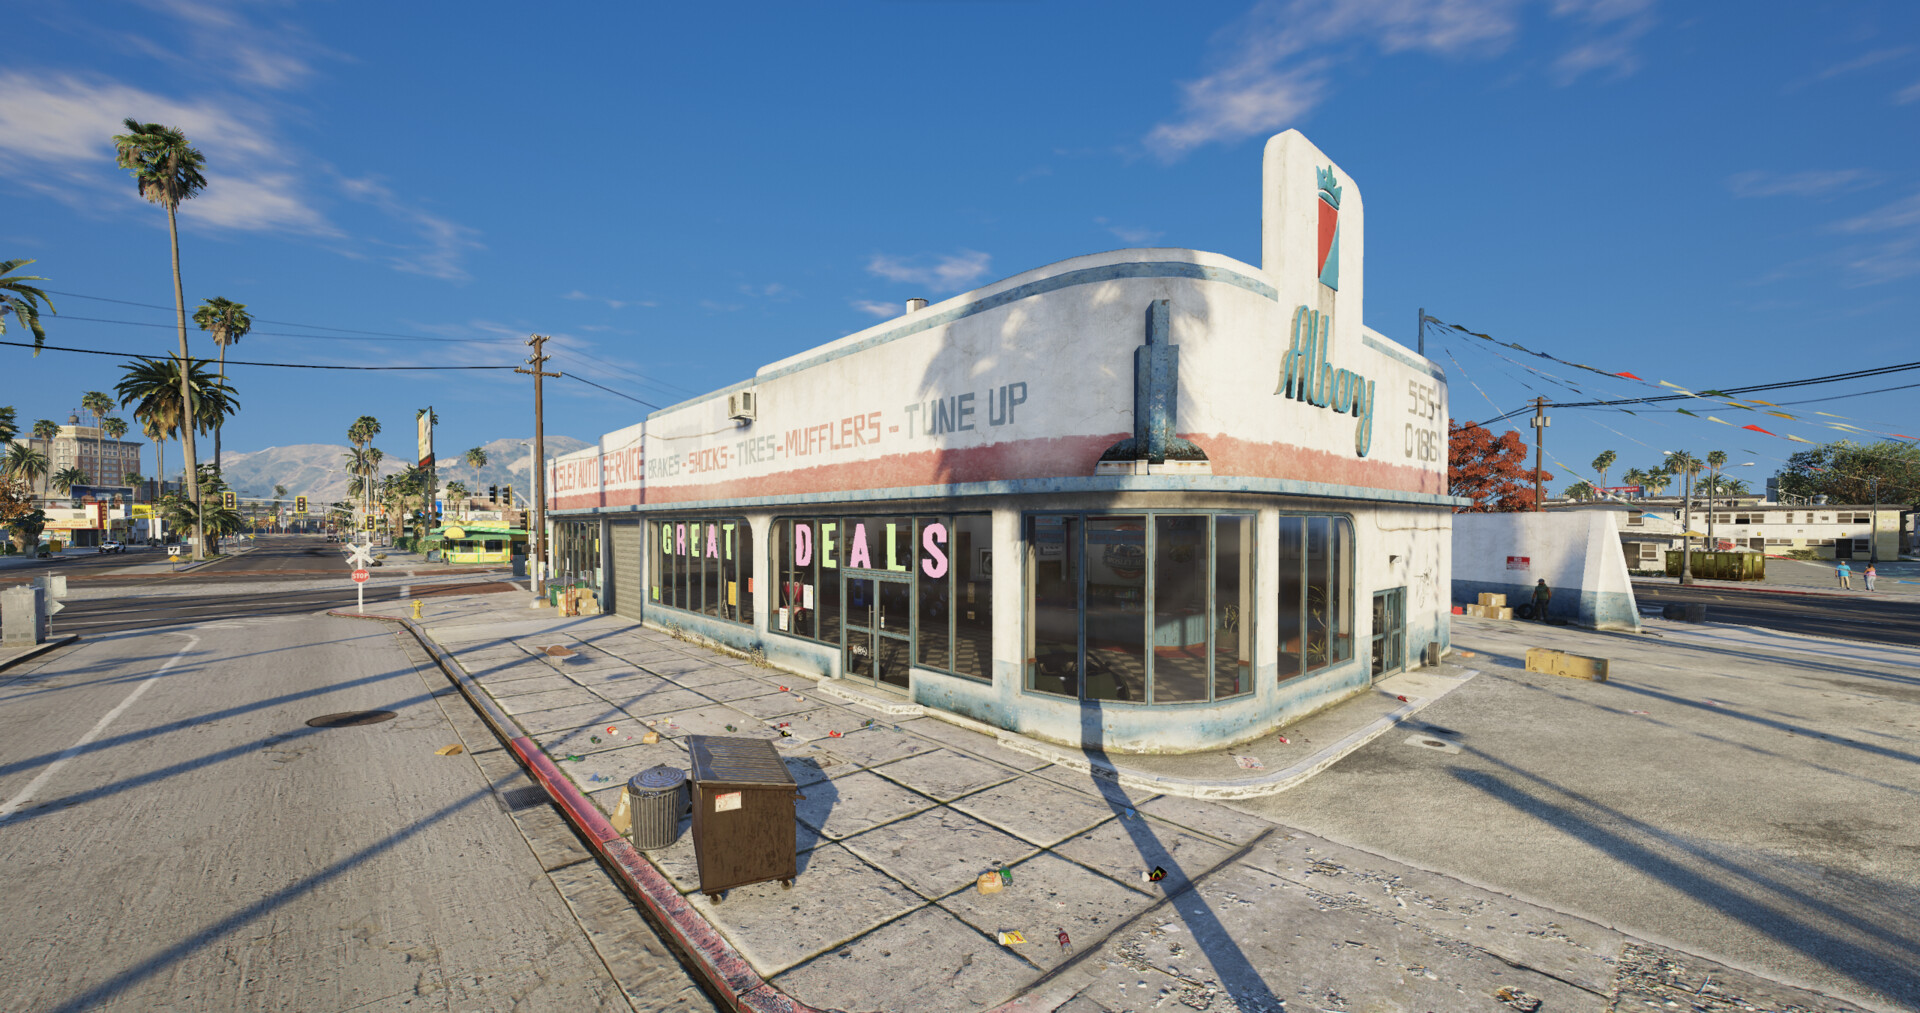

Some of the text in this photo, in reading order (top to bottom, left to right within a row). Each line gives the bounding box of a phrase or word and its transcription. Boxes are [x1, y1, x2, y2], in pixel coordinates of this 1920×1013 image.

[1274, 305, 1375, 457] Albany
[648, 454, 680, 479] BRAKES
[689, 446, 728, 474] SHOCKS
[736, 435, 776, 466] TIRES
[785, 411, 882, 458] MUFFLERS
[904, 392, 975, 439] TUNE
[989, 381, 1027, 426] UP
[1405, 423, 1437, 462] 0186
[550, 446, 644, 493] MOSLEY AUTO SERVICE
[662, 523, 734, 560] GREAT
[795, 523, 948, 578] DEALS
